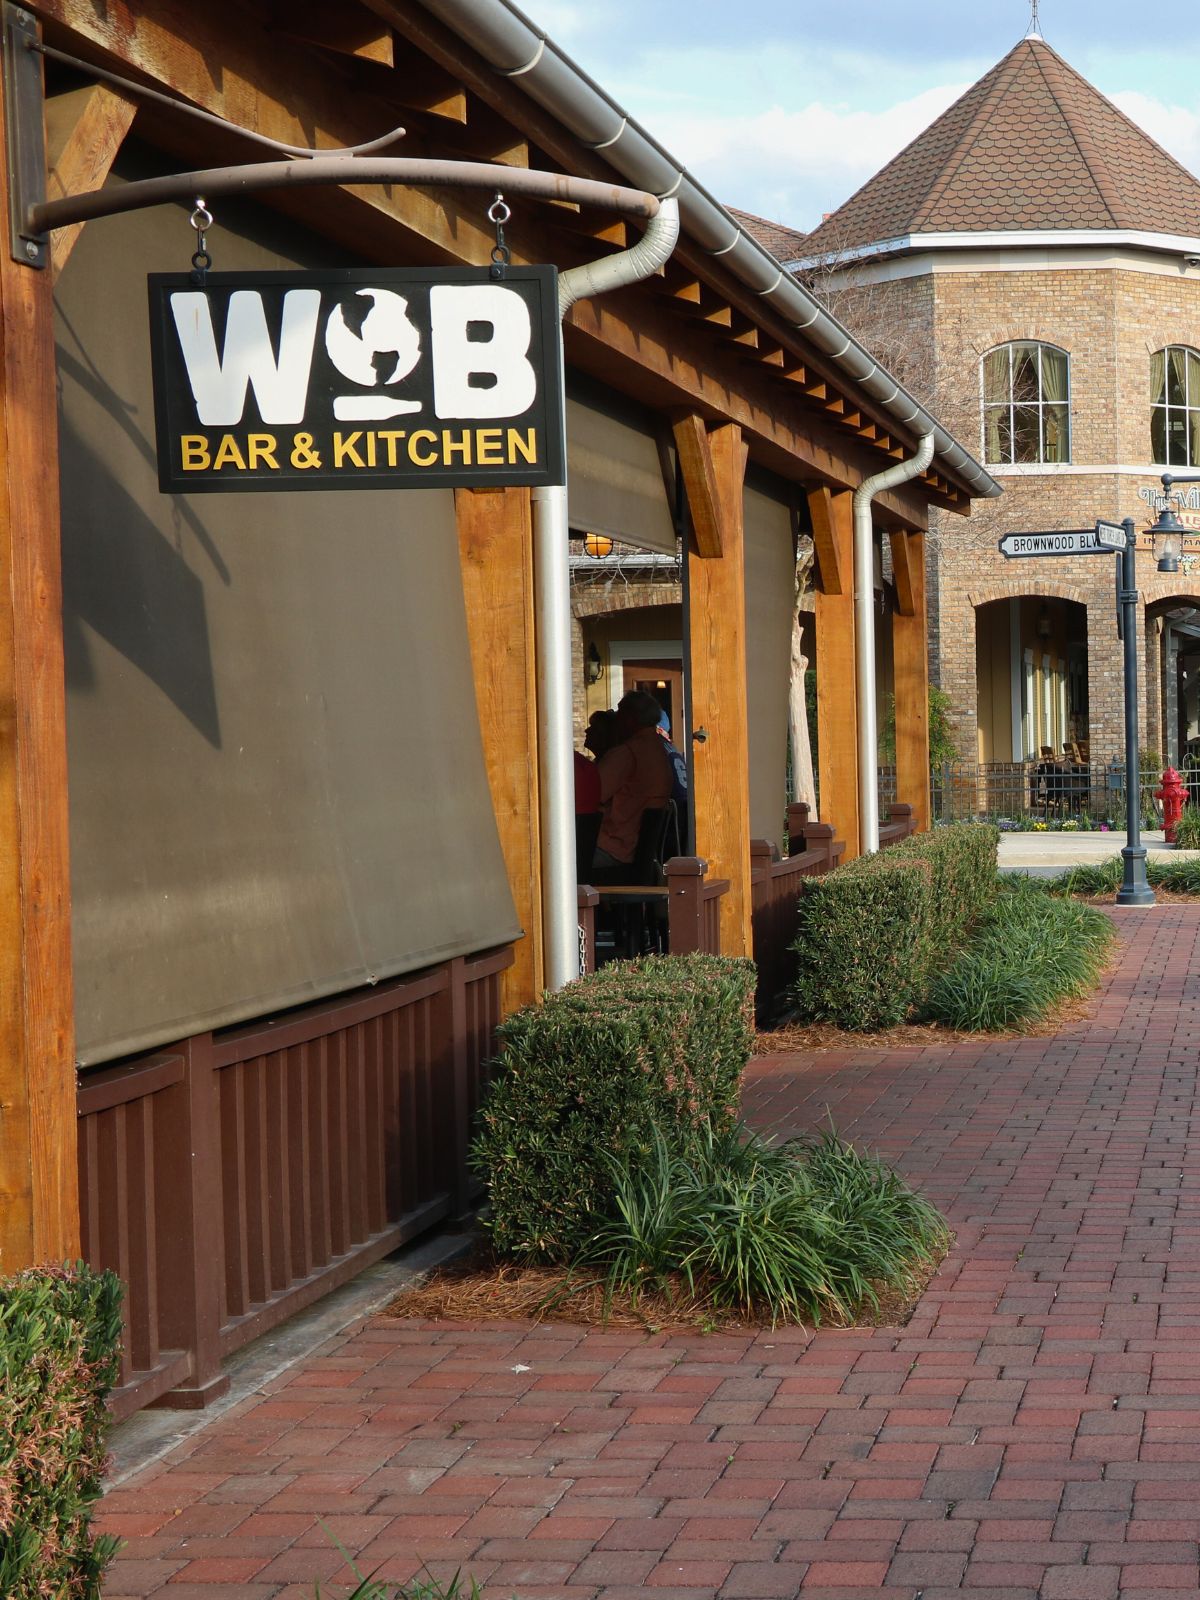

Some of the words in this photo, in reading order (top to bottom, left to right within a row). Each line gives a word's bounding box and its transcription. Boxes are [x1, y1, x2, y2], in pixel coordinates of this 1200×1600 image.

[180, 434, 280, 471] BAR
[290, 432, 322, 469] &
[333, 428, 537, 468] KITCHEN
[1138, 487, 1171, 510] The
[1013, 536, 1074, 552] BROWNWOOD
[1080, 535, 1098, 548] BLV
